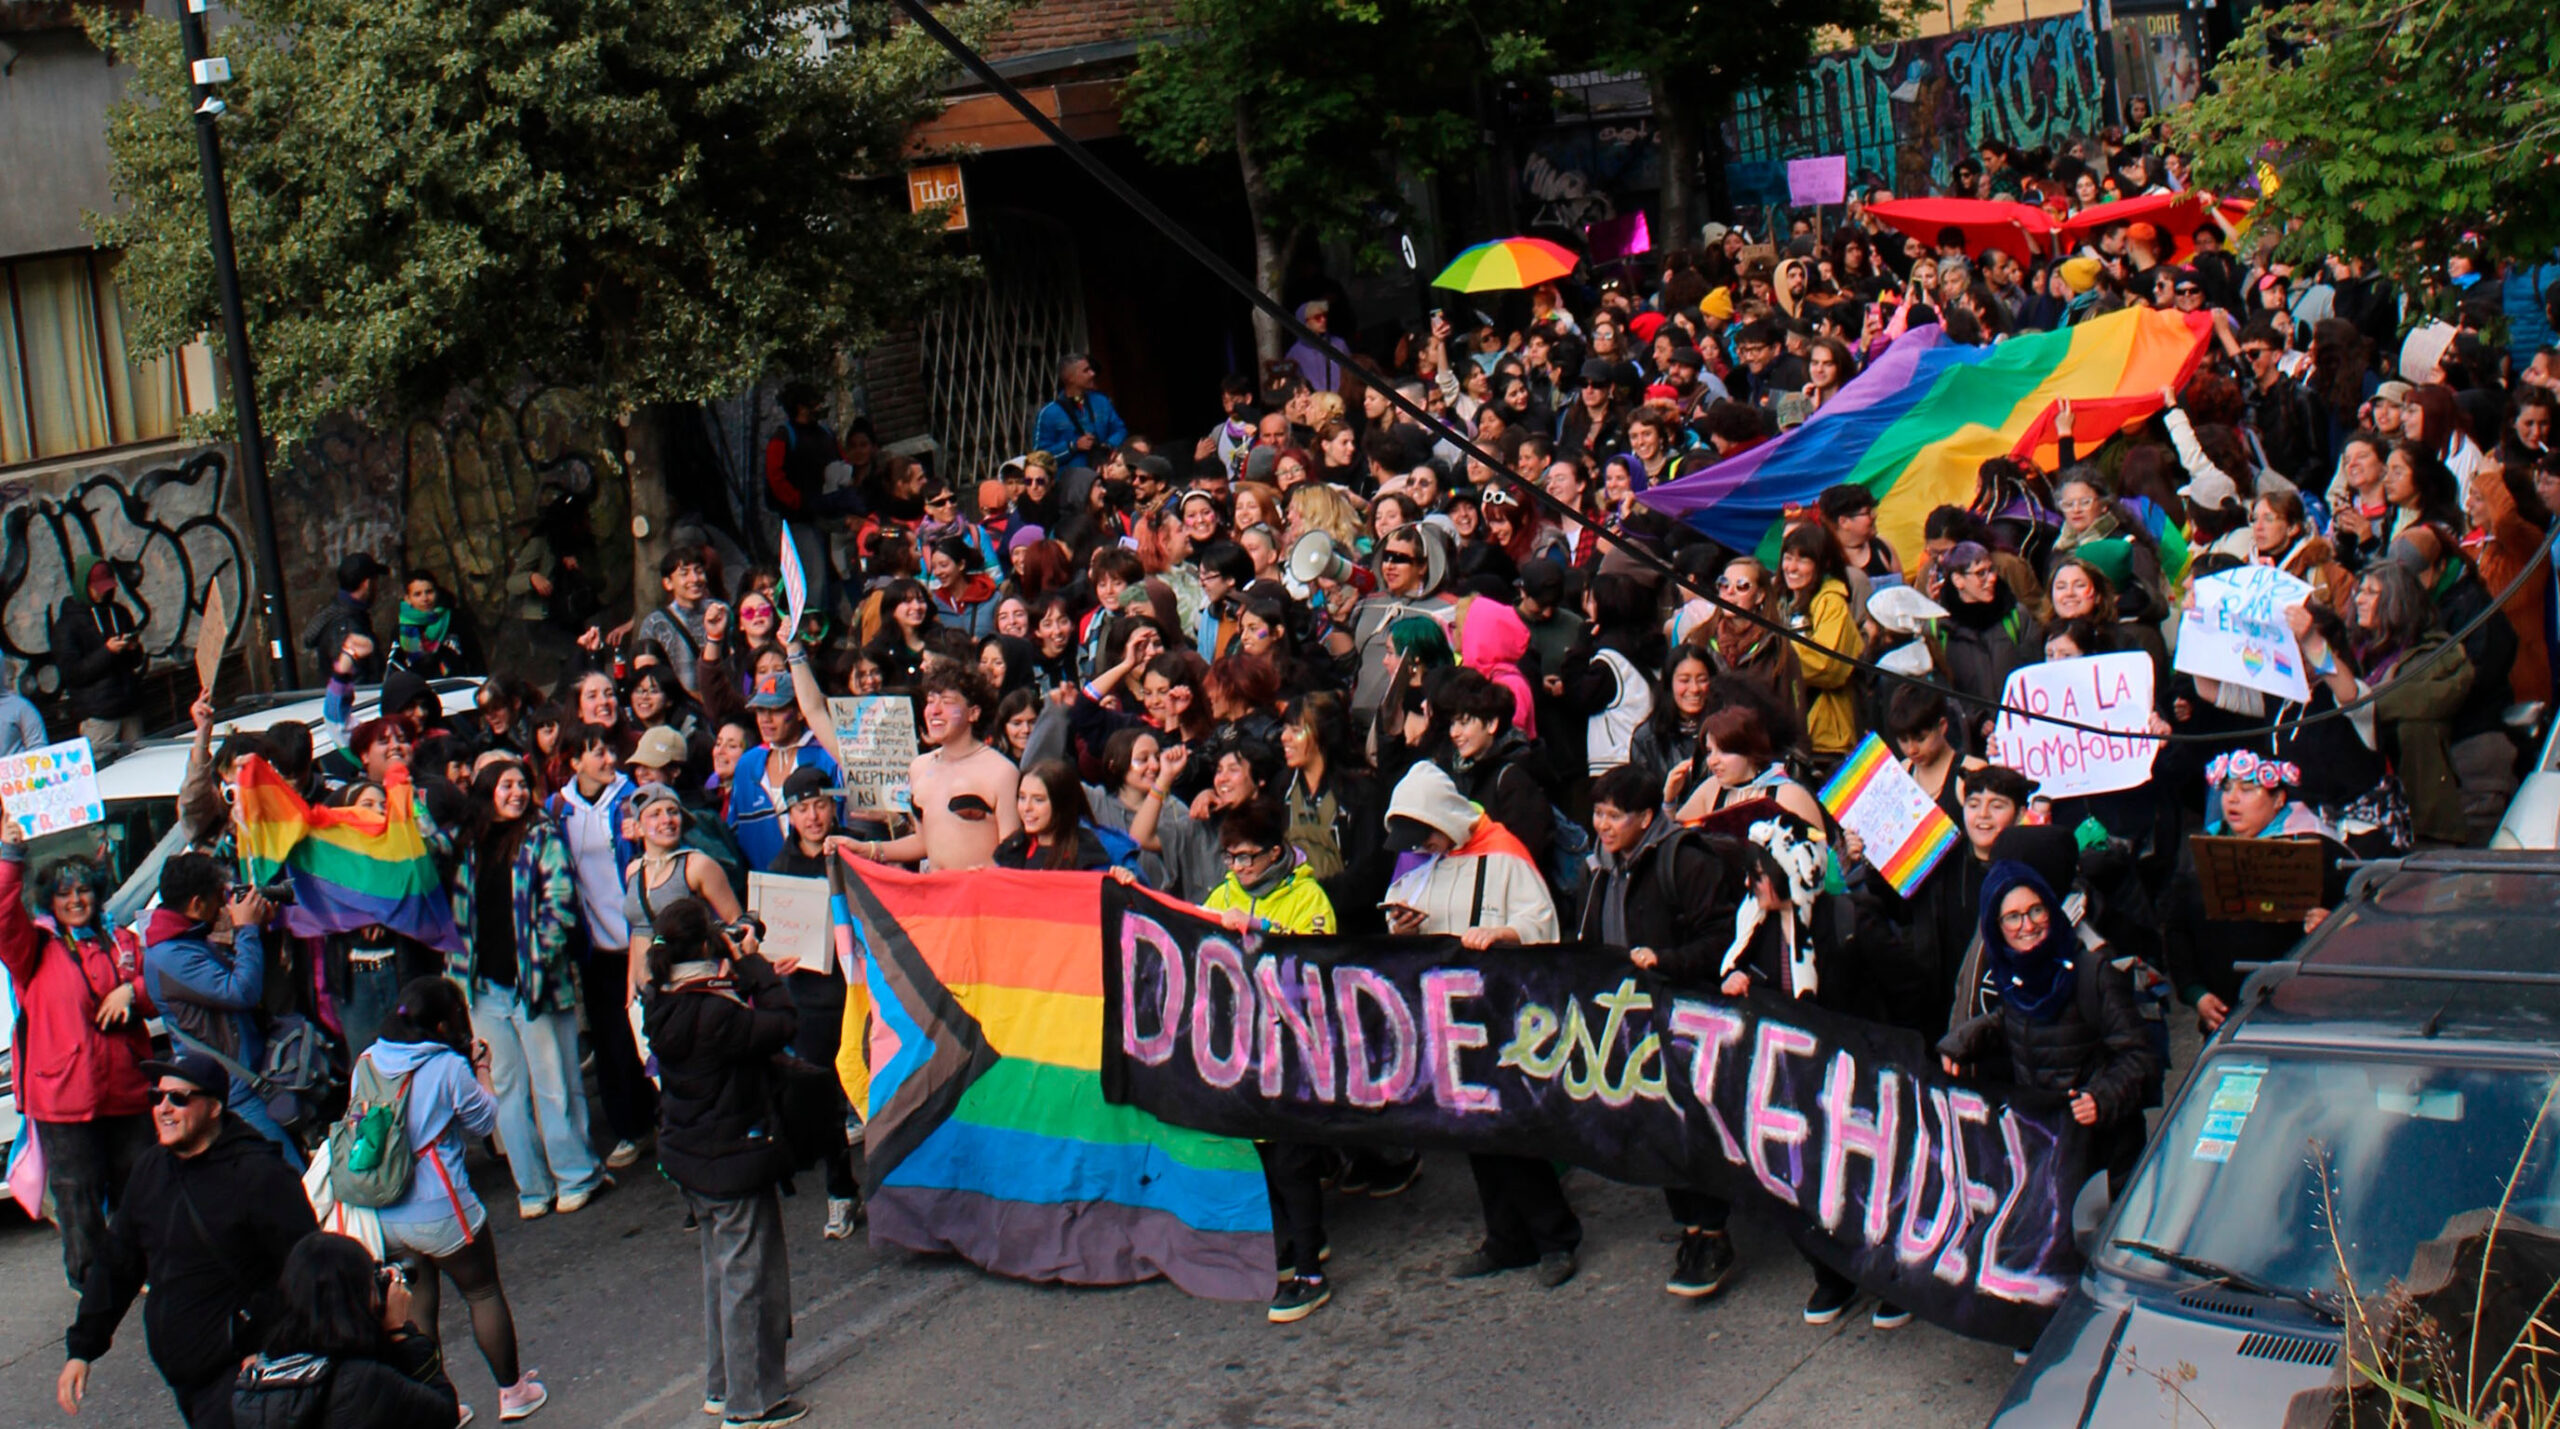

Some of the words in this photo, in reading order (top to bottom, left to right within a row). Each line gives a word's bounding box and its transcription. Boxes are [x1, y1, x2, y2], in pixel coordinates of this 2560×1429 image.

[913, 180, 958, 203] Tito
[2005, 675, 2049, 731] NO
[2062, 686, 2079, 718] A
[2093, 664, 2131, 711] LA
[847, 769, 911, 786] ACEPTARNO
[1669, 997, 2067, 1304] TEHUEL
